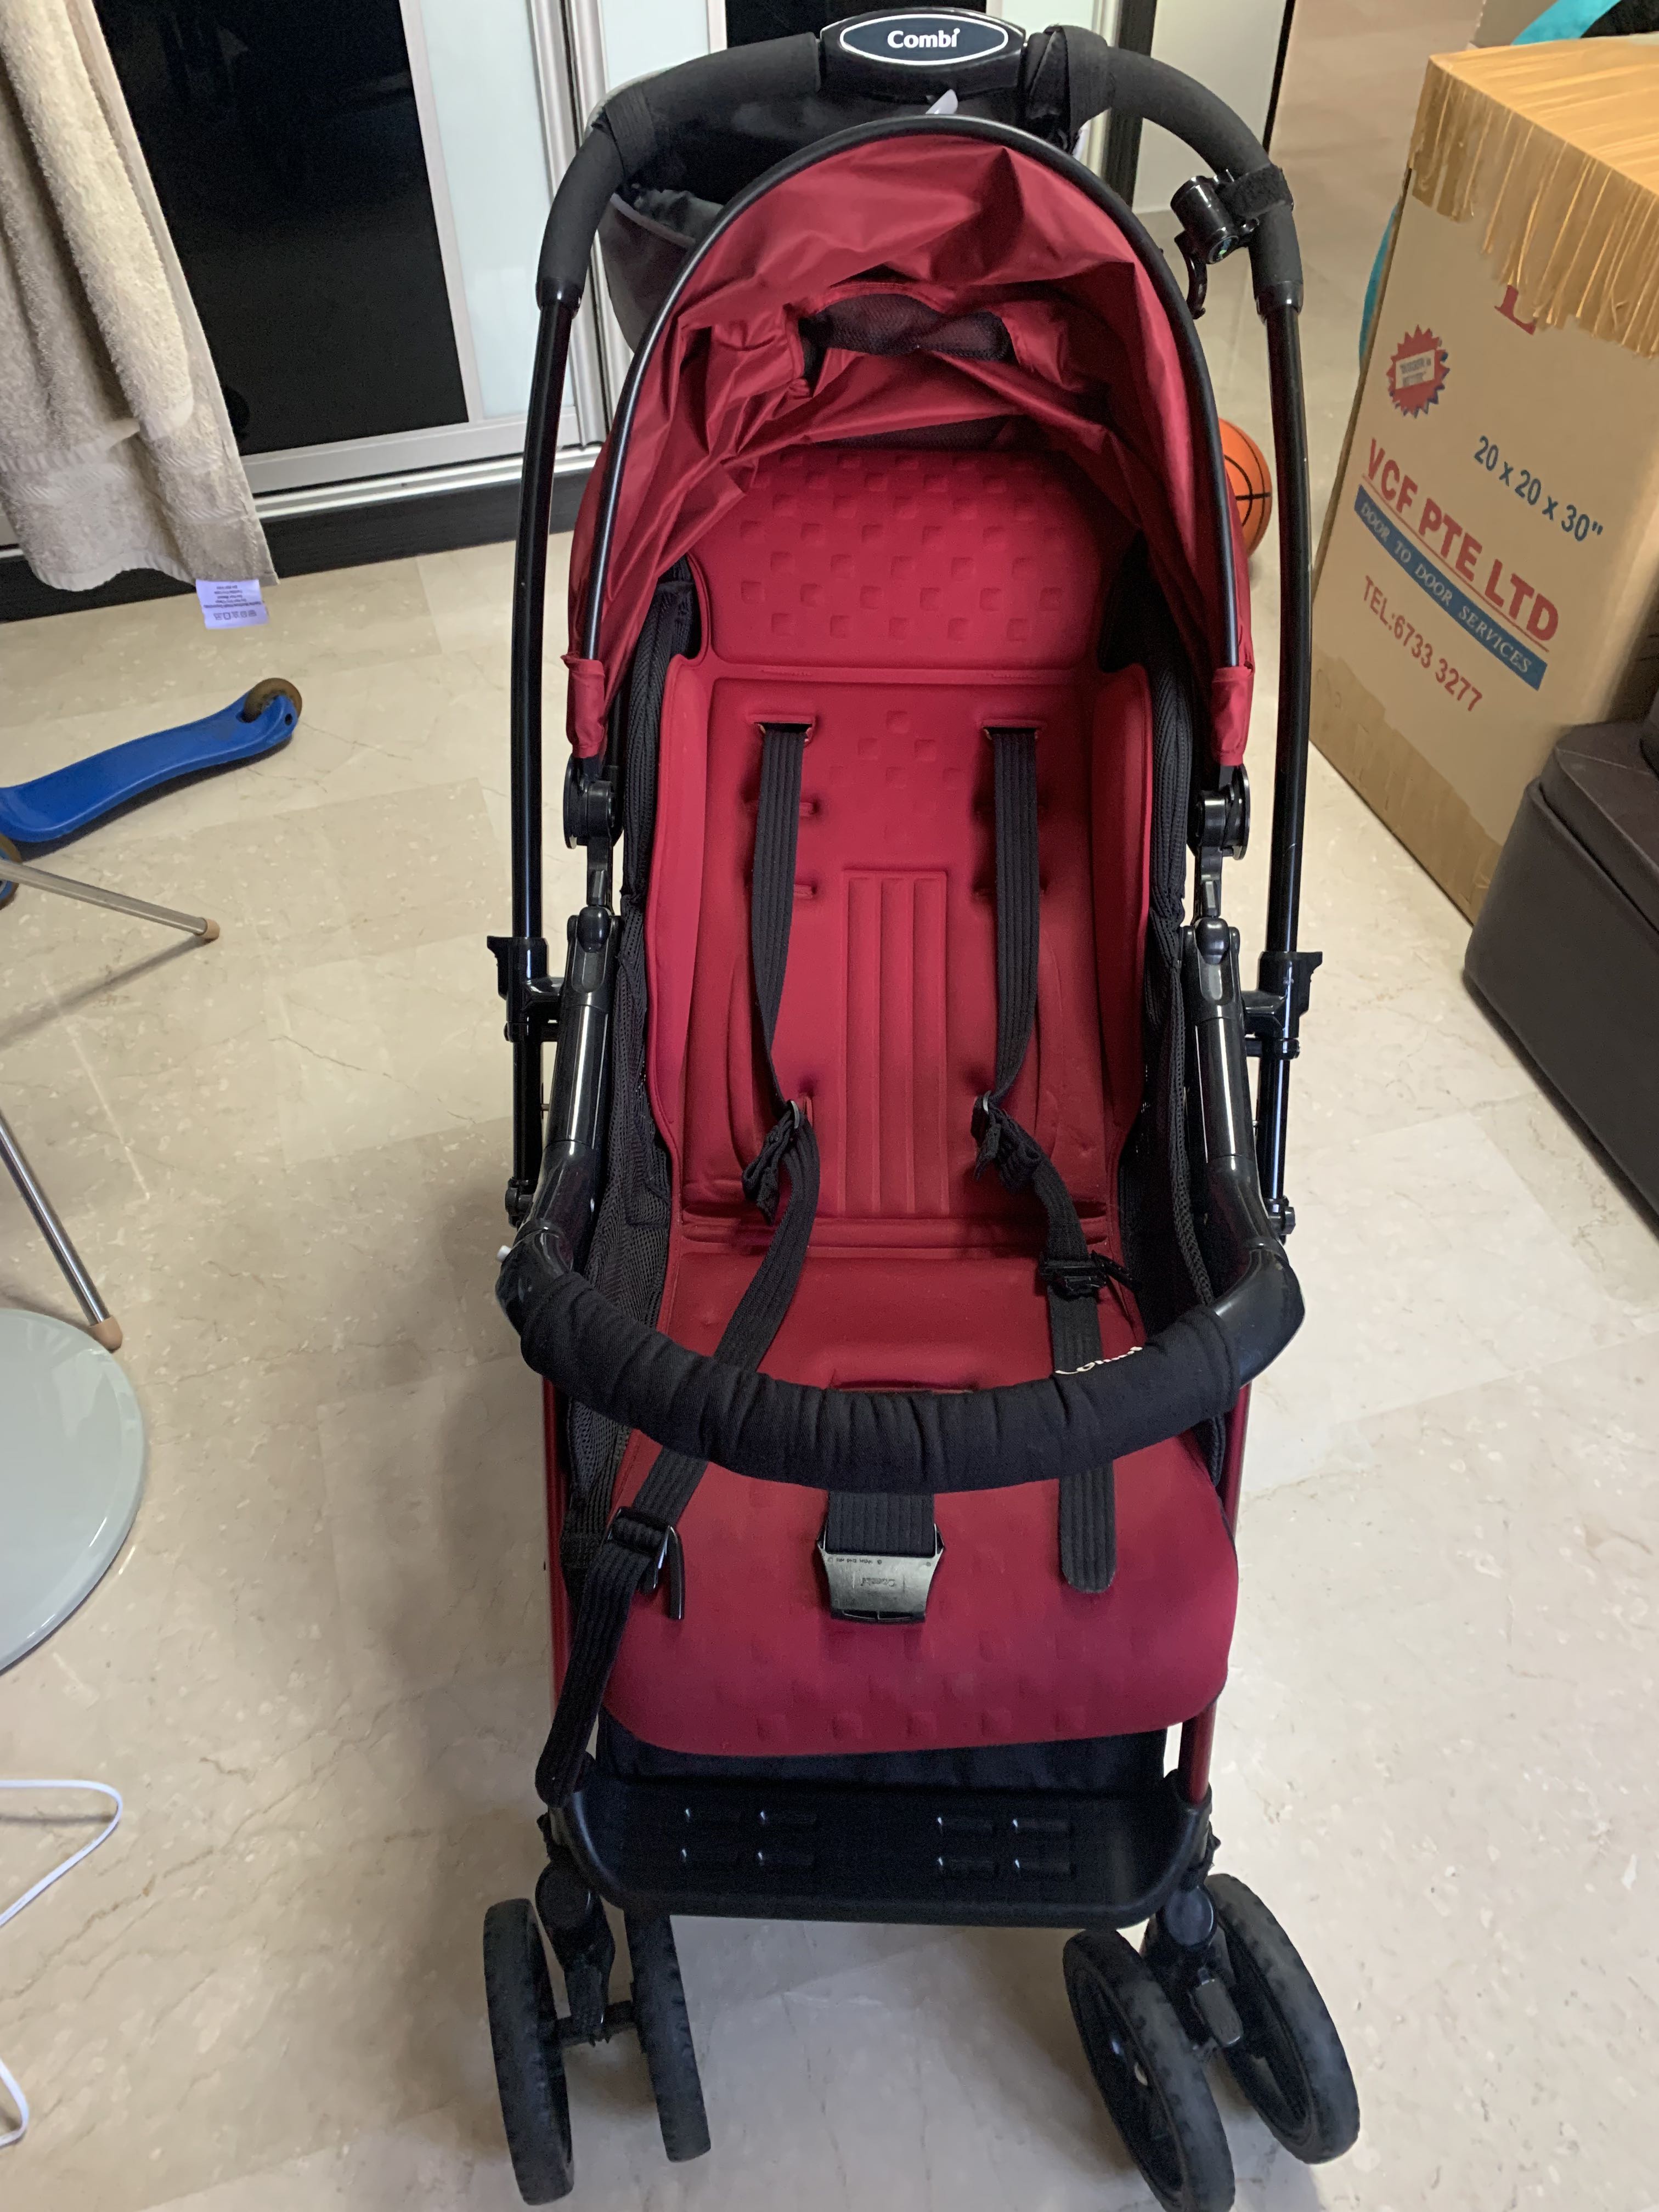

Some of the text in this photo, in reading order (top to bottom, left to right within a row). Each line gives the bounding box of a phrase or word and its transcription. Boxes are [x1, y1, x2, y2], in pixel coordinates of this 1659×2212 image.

[887, 28, 960, 48] Combi
[1474, 435, 1499, 471] 20
[1514, 469, 1542, 505] 20
[1368, 437, 1559, 641] VCF PTE LTD
[1361, 501, 1533, 674] DOOR TO DOOR SERVICES
[1435, 658, 1483, 712] 3277
